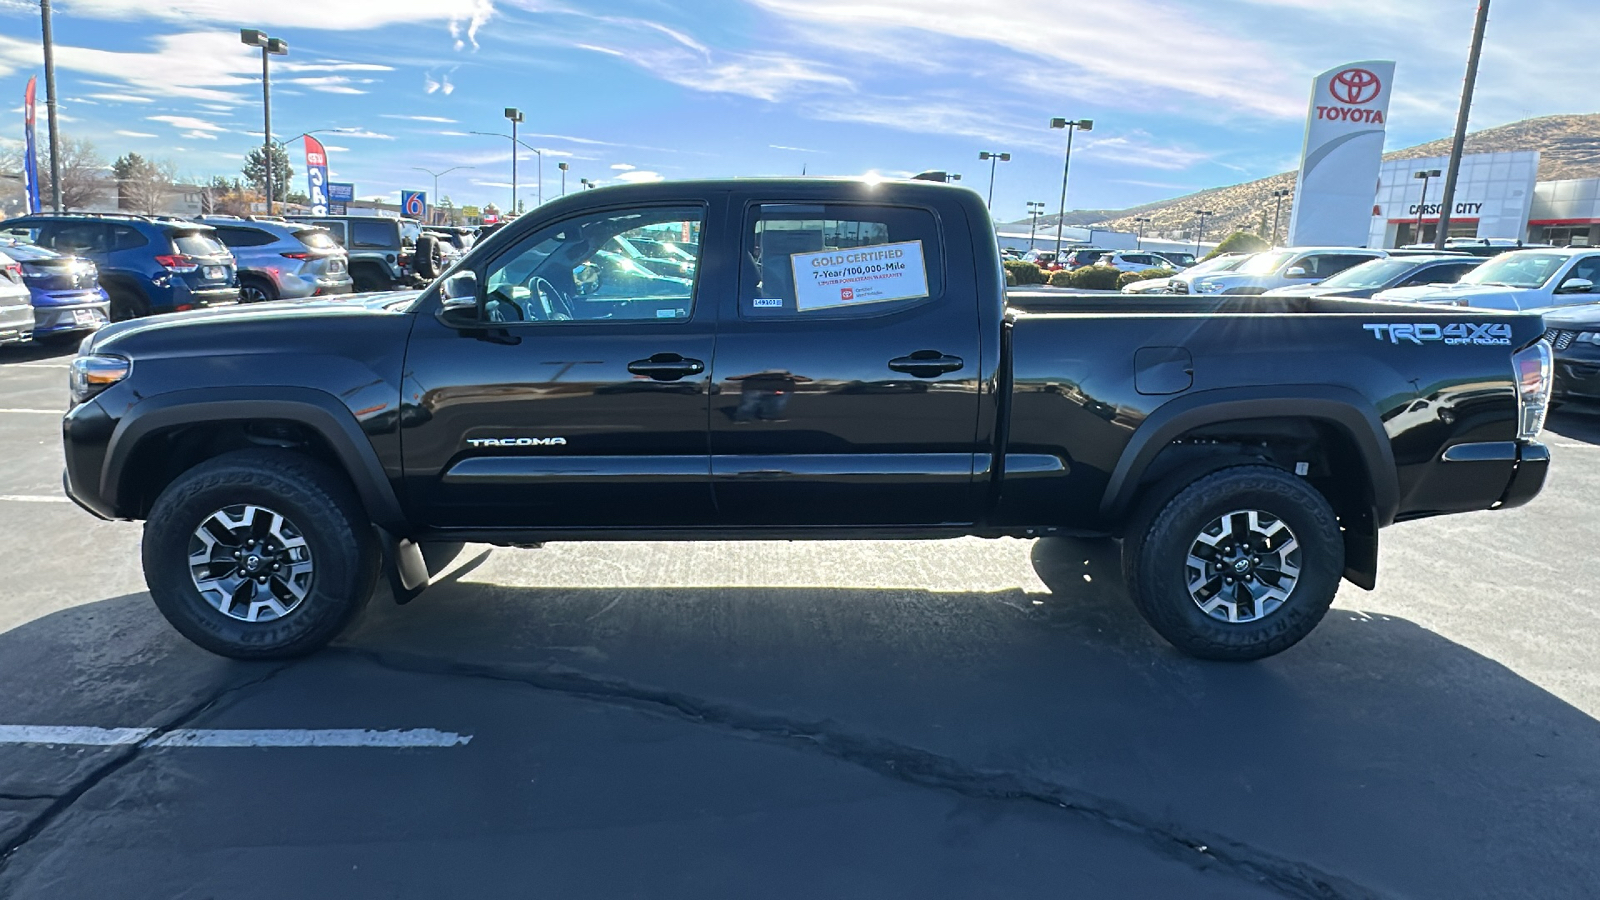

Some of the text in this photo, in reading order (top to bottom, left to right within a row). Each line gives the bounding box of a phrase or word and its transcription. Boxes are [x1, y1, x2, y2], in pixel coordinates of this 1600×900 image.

[1316, 106, 1384, 124] TOYOTA
[406, 192, 424, 216] 6
[1456, 203, 1482, 214] CITY
[812, 249, 903, 267] GOLD CERTIFIED
[813, 262, 905, 279] 7-Year/100,000-Mile
[1363, 323, 1512, 345] TRD 4X4
[466, 437, 567, 447] TACOMA
